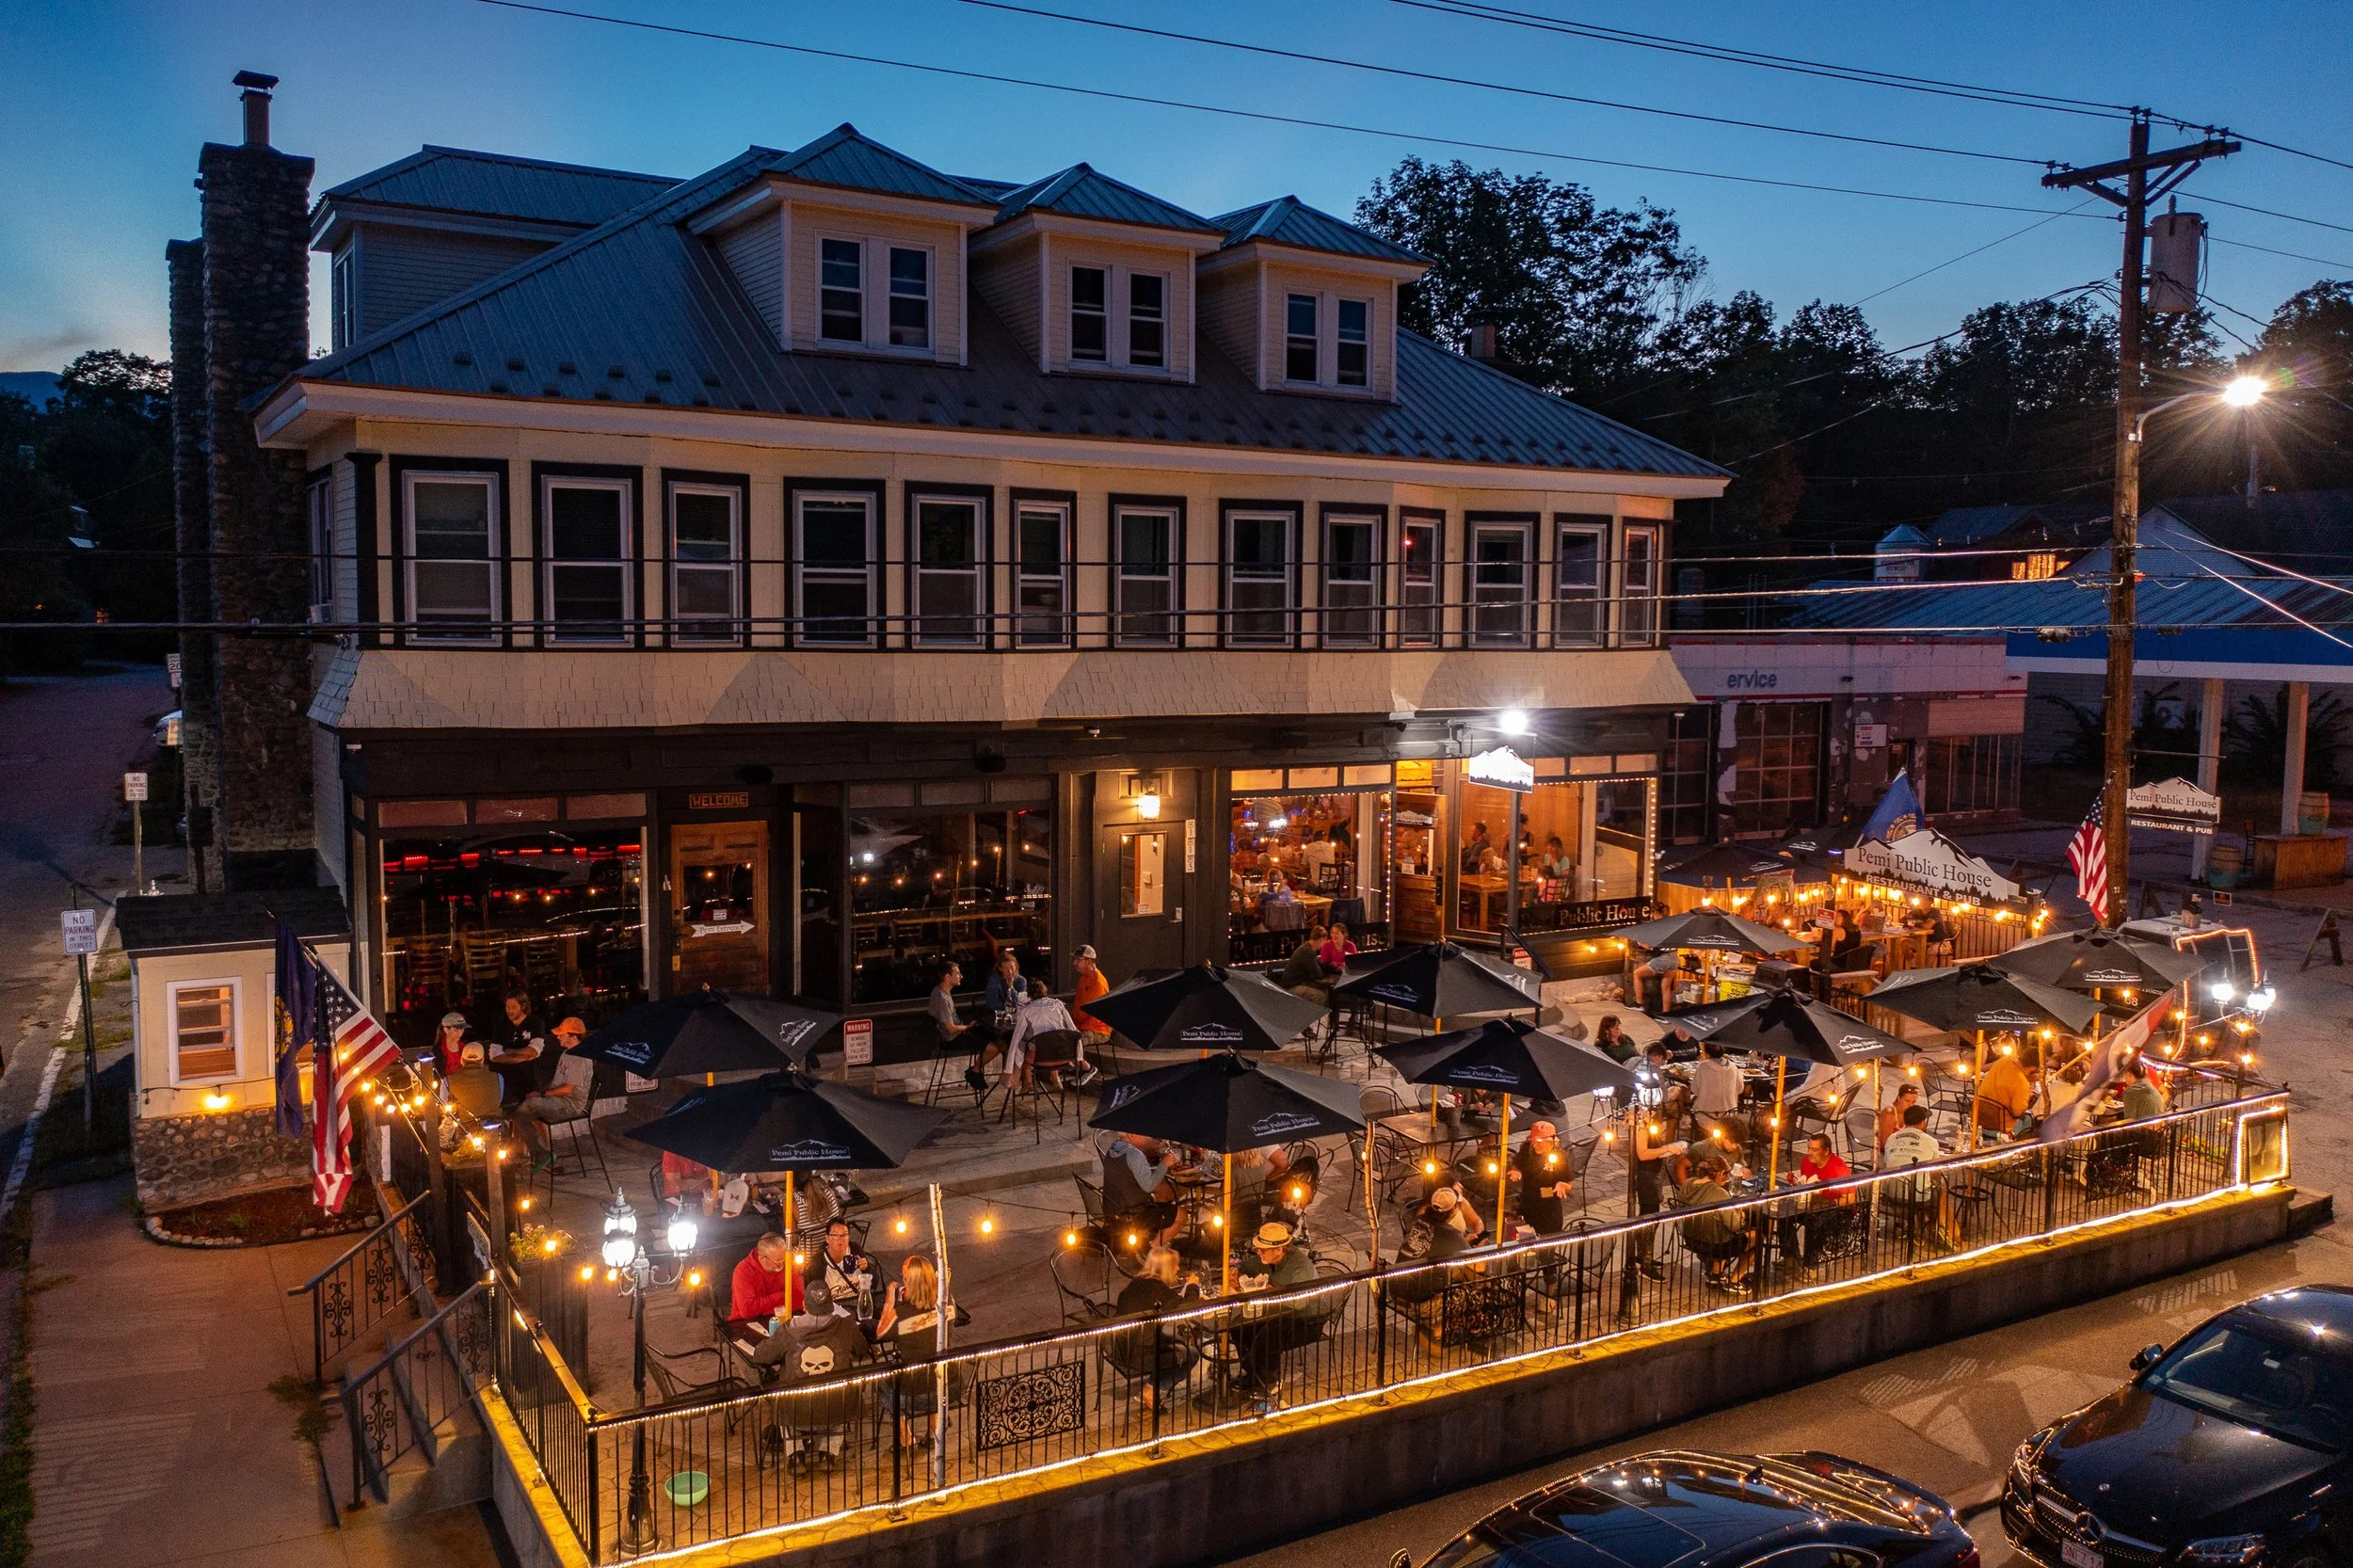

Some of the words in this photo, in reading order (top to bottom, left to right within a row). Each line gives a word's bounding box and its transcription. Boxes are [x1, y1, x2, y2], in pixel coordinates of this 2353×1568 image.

[1727, 669, 1778, 688] ervice
[692, 793, 746, 807] WELCOME
[2130, 792, 2153, 803] Pemi
[2154, 793, 2185, 805] Public
[2186, 796, 2217, 808] House
[2130, 819, 2185, 831] RESTAURANT
[2195, 826, 2213, 835] PUB
[1858, 847, 1891, 868] Pemi
[1895, 854, 1939, 877] Public
[1943, 864, 1993, 888] House
[1865, 874, 1941, 897] RESTAURANT
[1943, 890, 1952, 901] &
[1955, 893, 1981, 906] PUB
[72, 916, 85, 924] NO
[1559, 906, 1602, 925] Public
[1606, 904, 1650, 920] Houe
[66, 924, 95, 935] PARKING
[847, 1022, 870, 1032] WARNING
[820, 1147, 848, 1156] House
